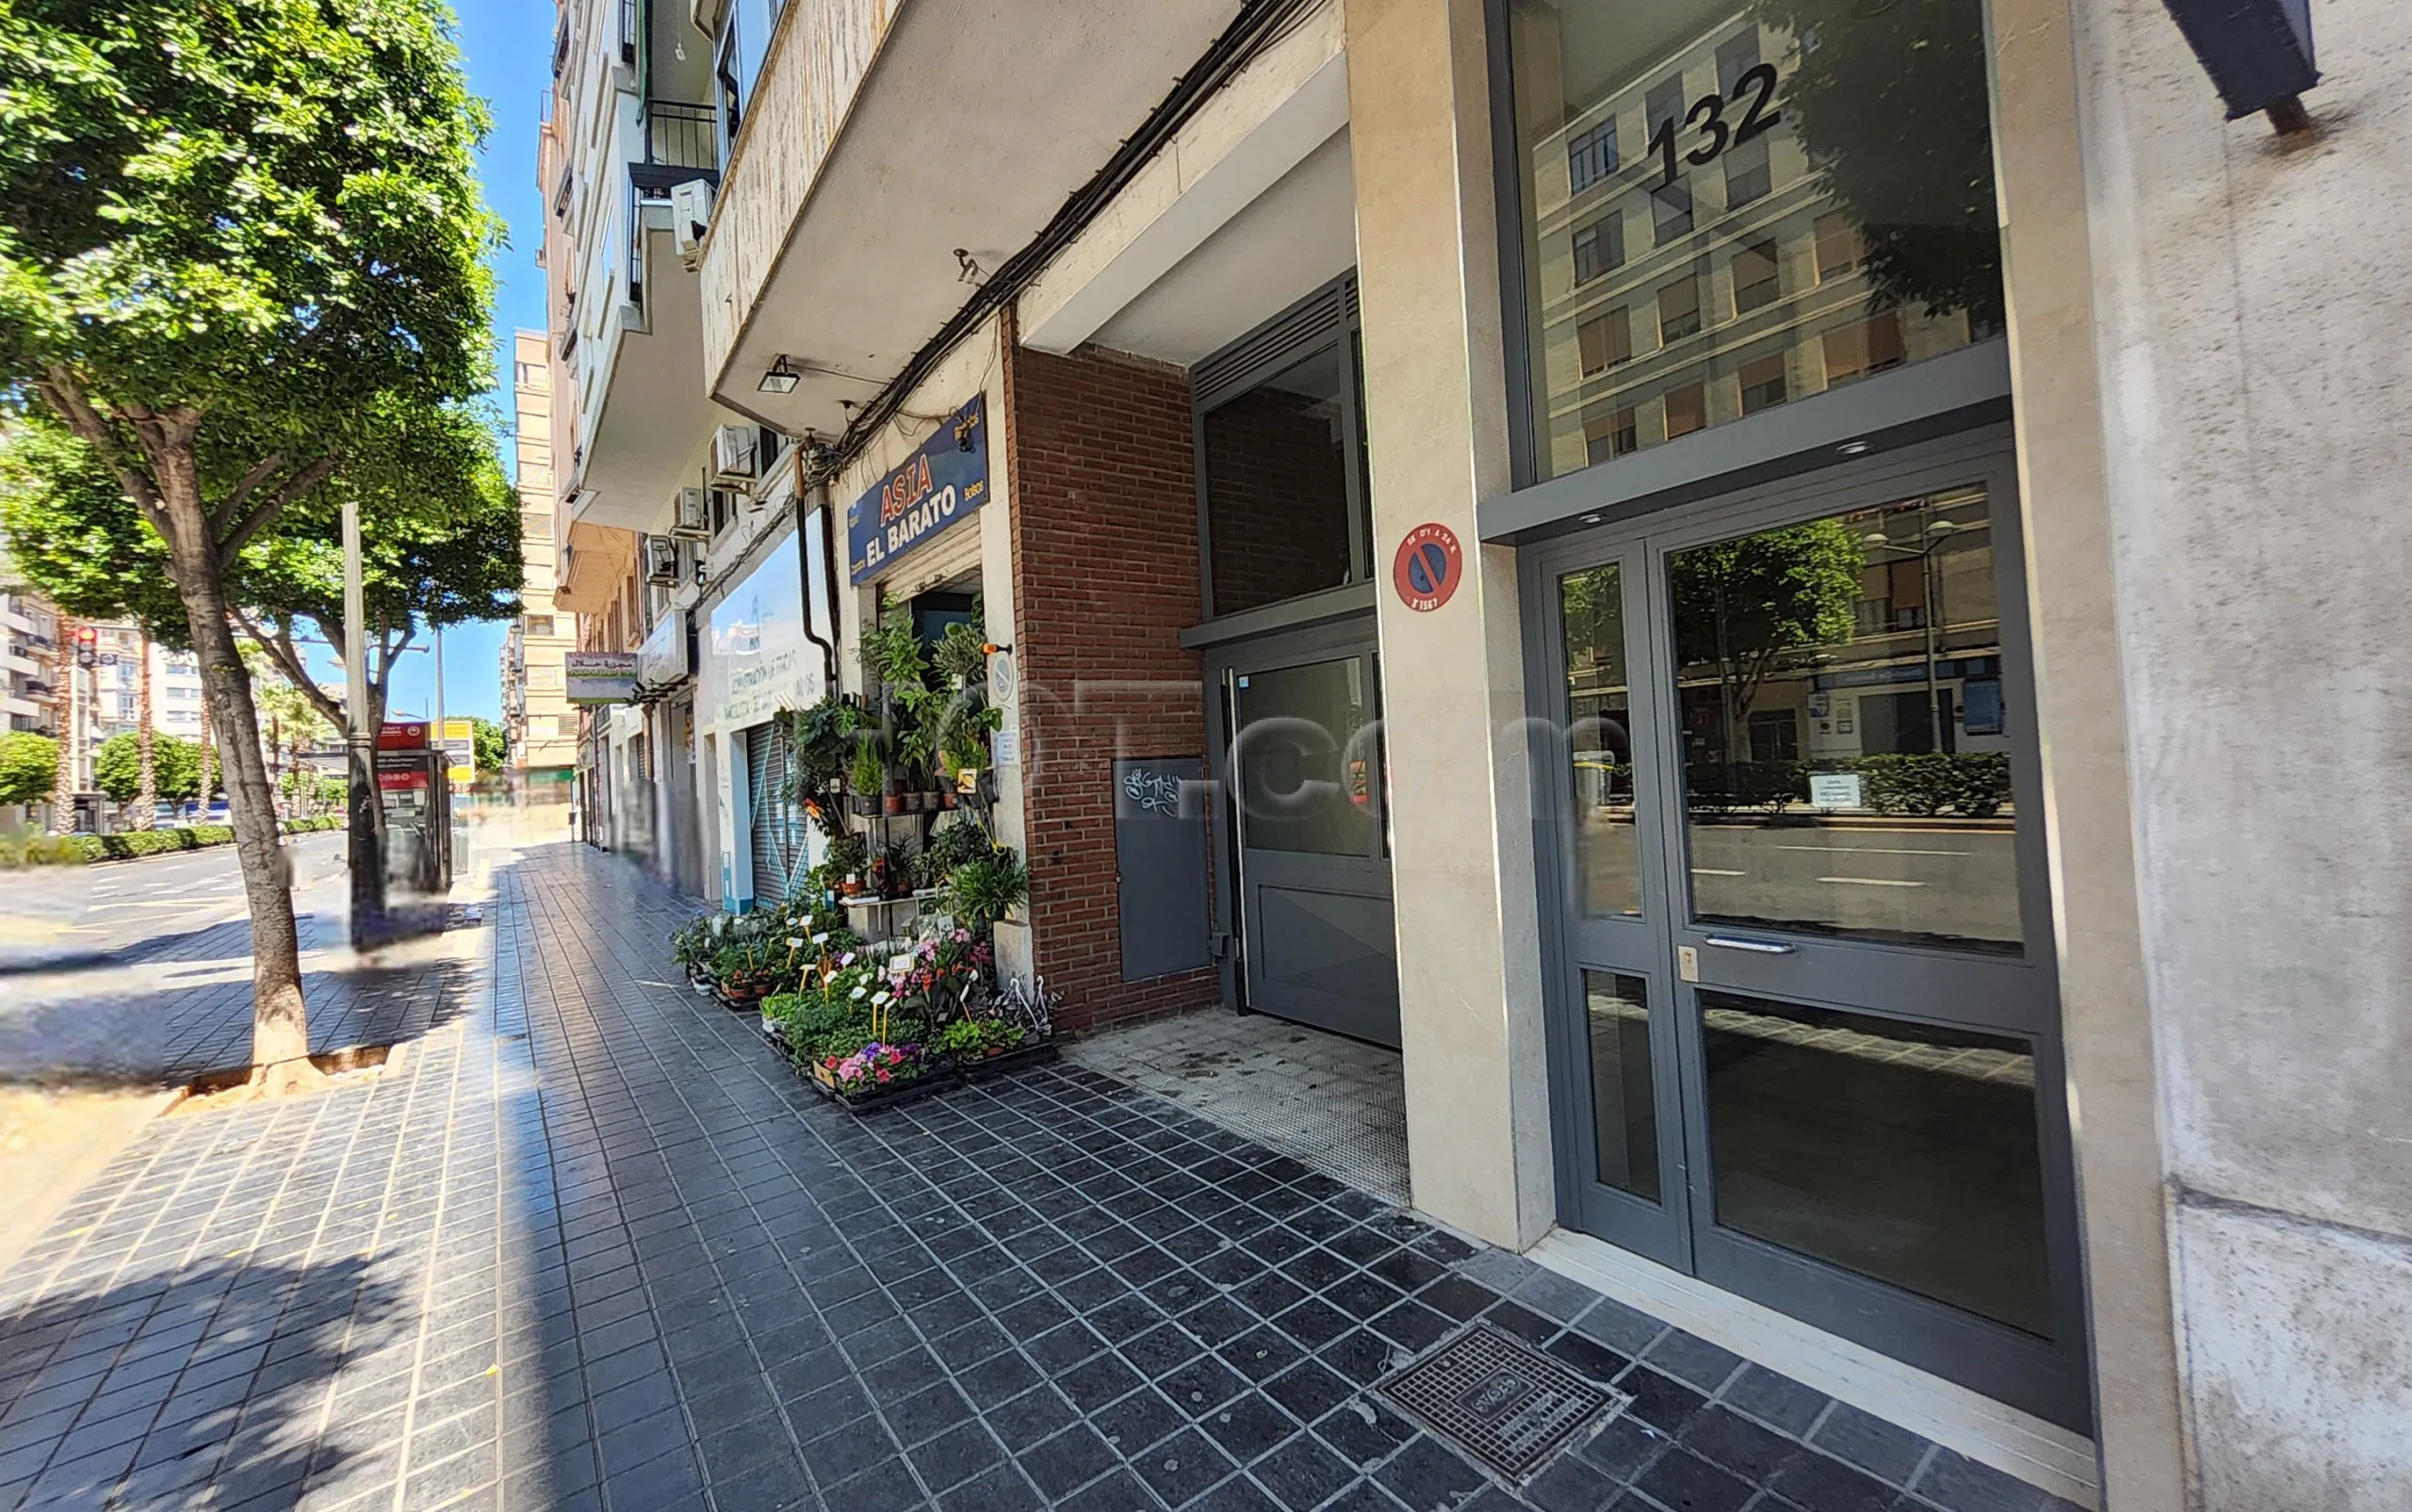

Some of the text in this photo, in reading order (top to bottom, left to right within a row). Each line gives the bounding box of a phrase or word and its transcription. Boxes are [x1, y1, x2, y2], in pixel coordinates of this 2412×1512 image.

[1648, 62, 1781, 185] 132
[866, 484, 956, 568] EL BARATO
[880, 453, 933, 528] ASIA
